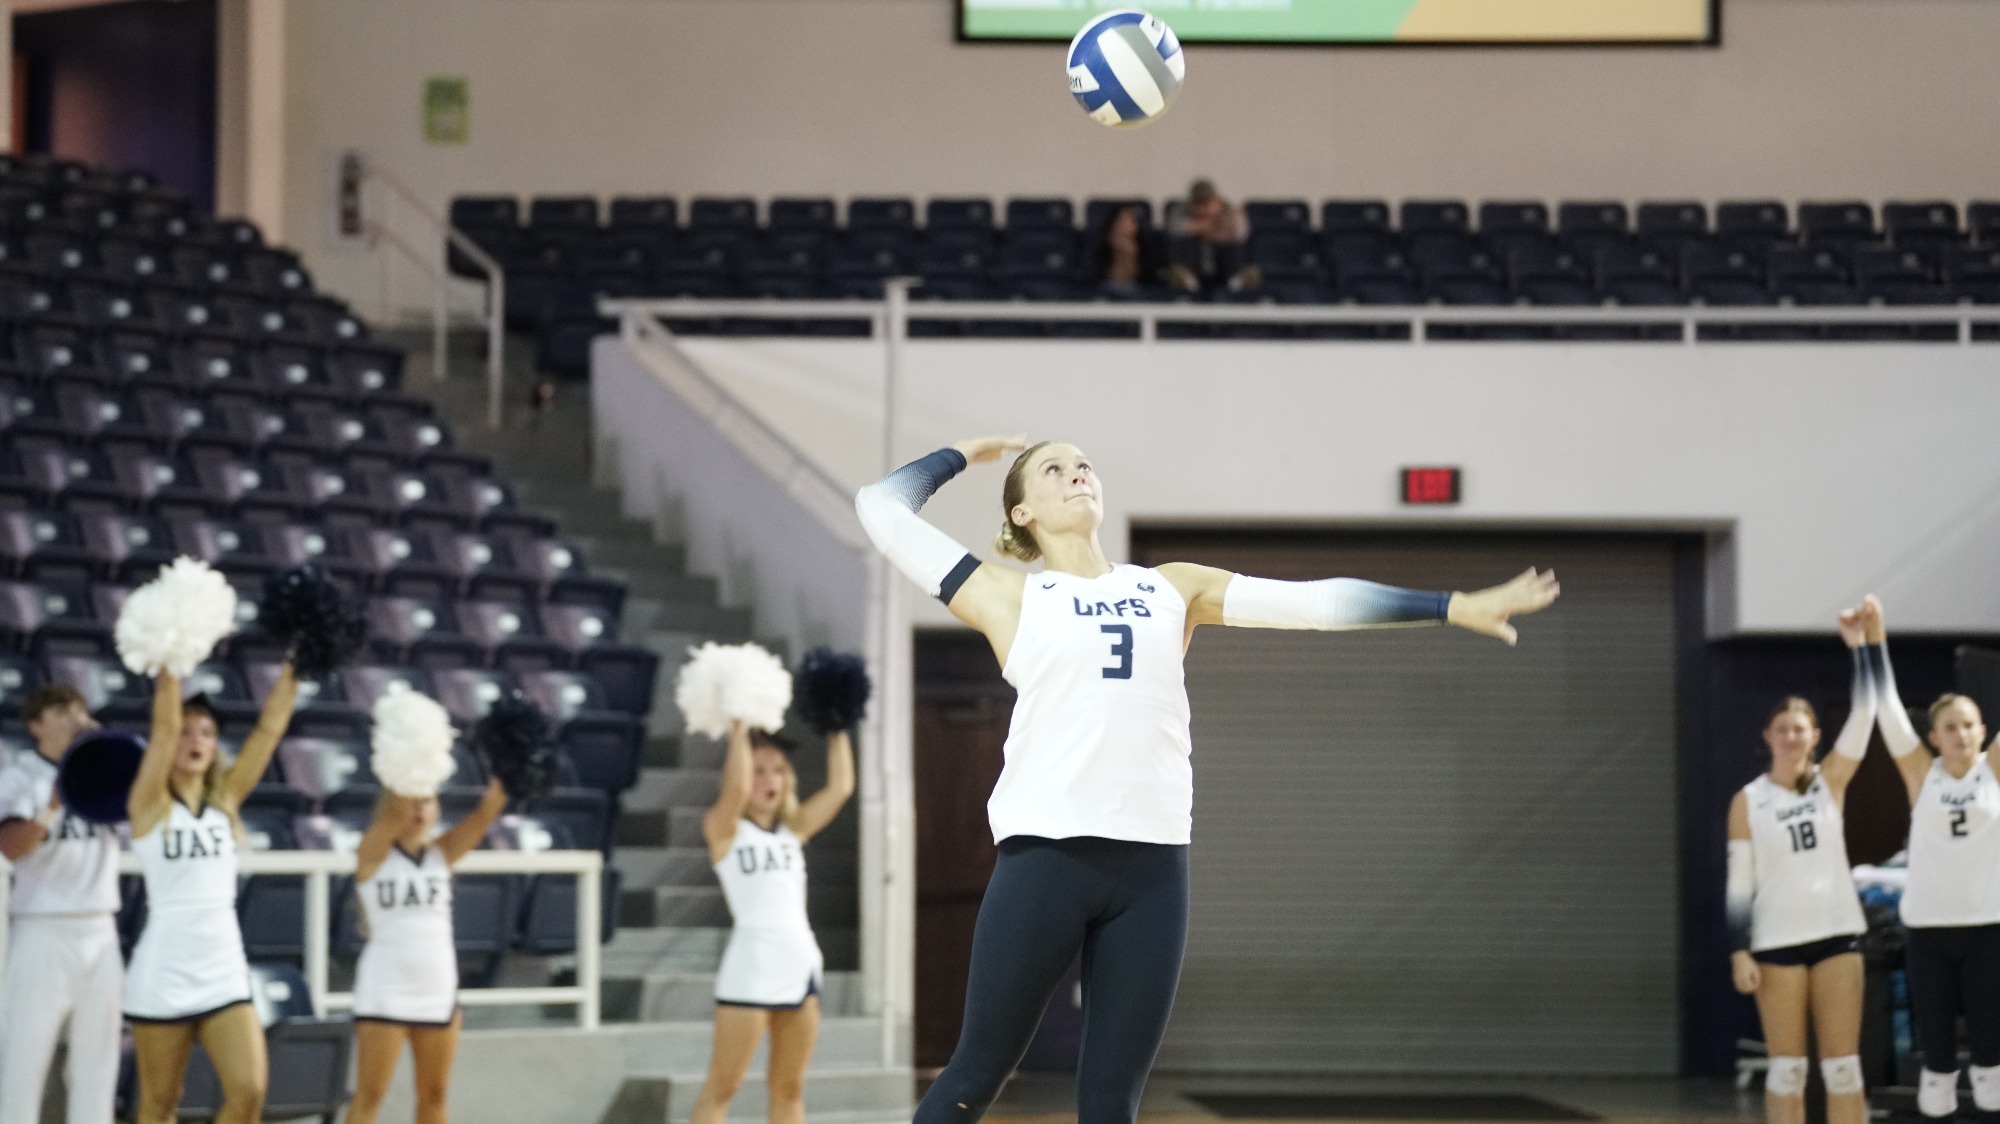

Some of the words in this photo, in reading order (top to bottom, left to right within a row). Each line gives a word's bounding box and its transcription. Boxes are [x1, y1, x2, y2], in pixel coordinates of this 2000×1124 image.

[1100, 624, 1133, 680] 3
[1787, 821, 1817, 852] 18
[1949, 810, 1968, 837] 2
[162, 826, 224, 860] UAF
